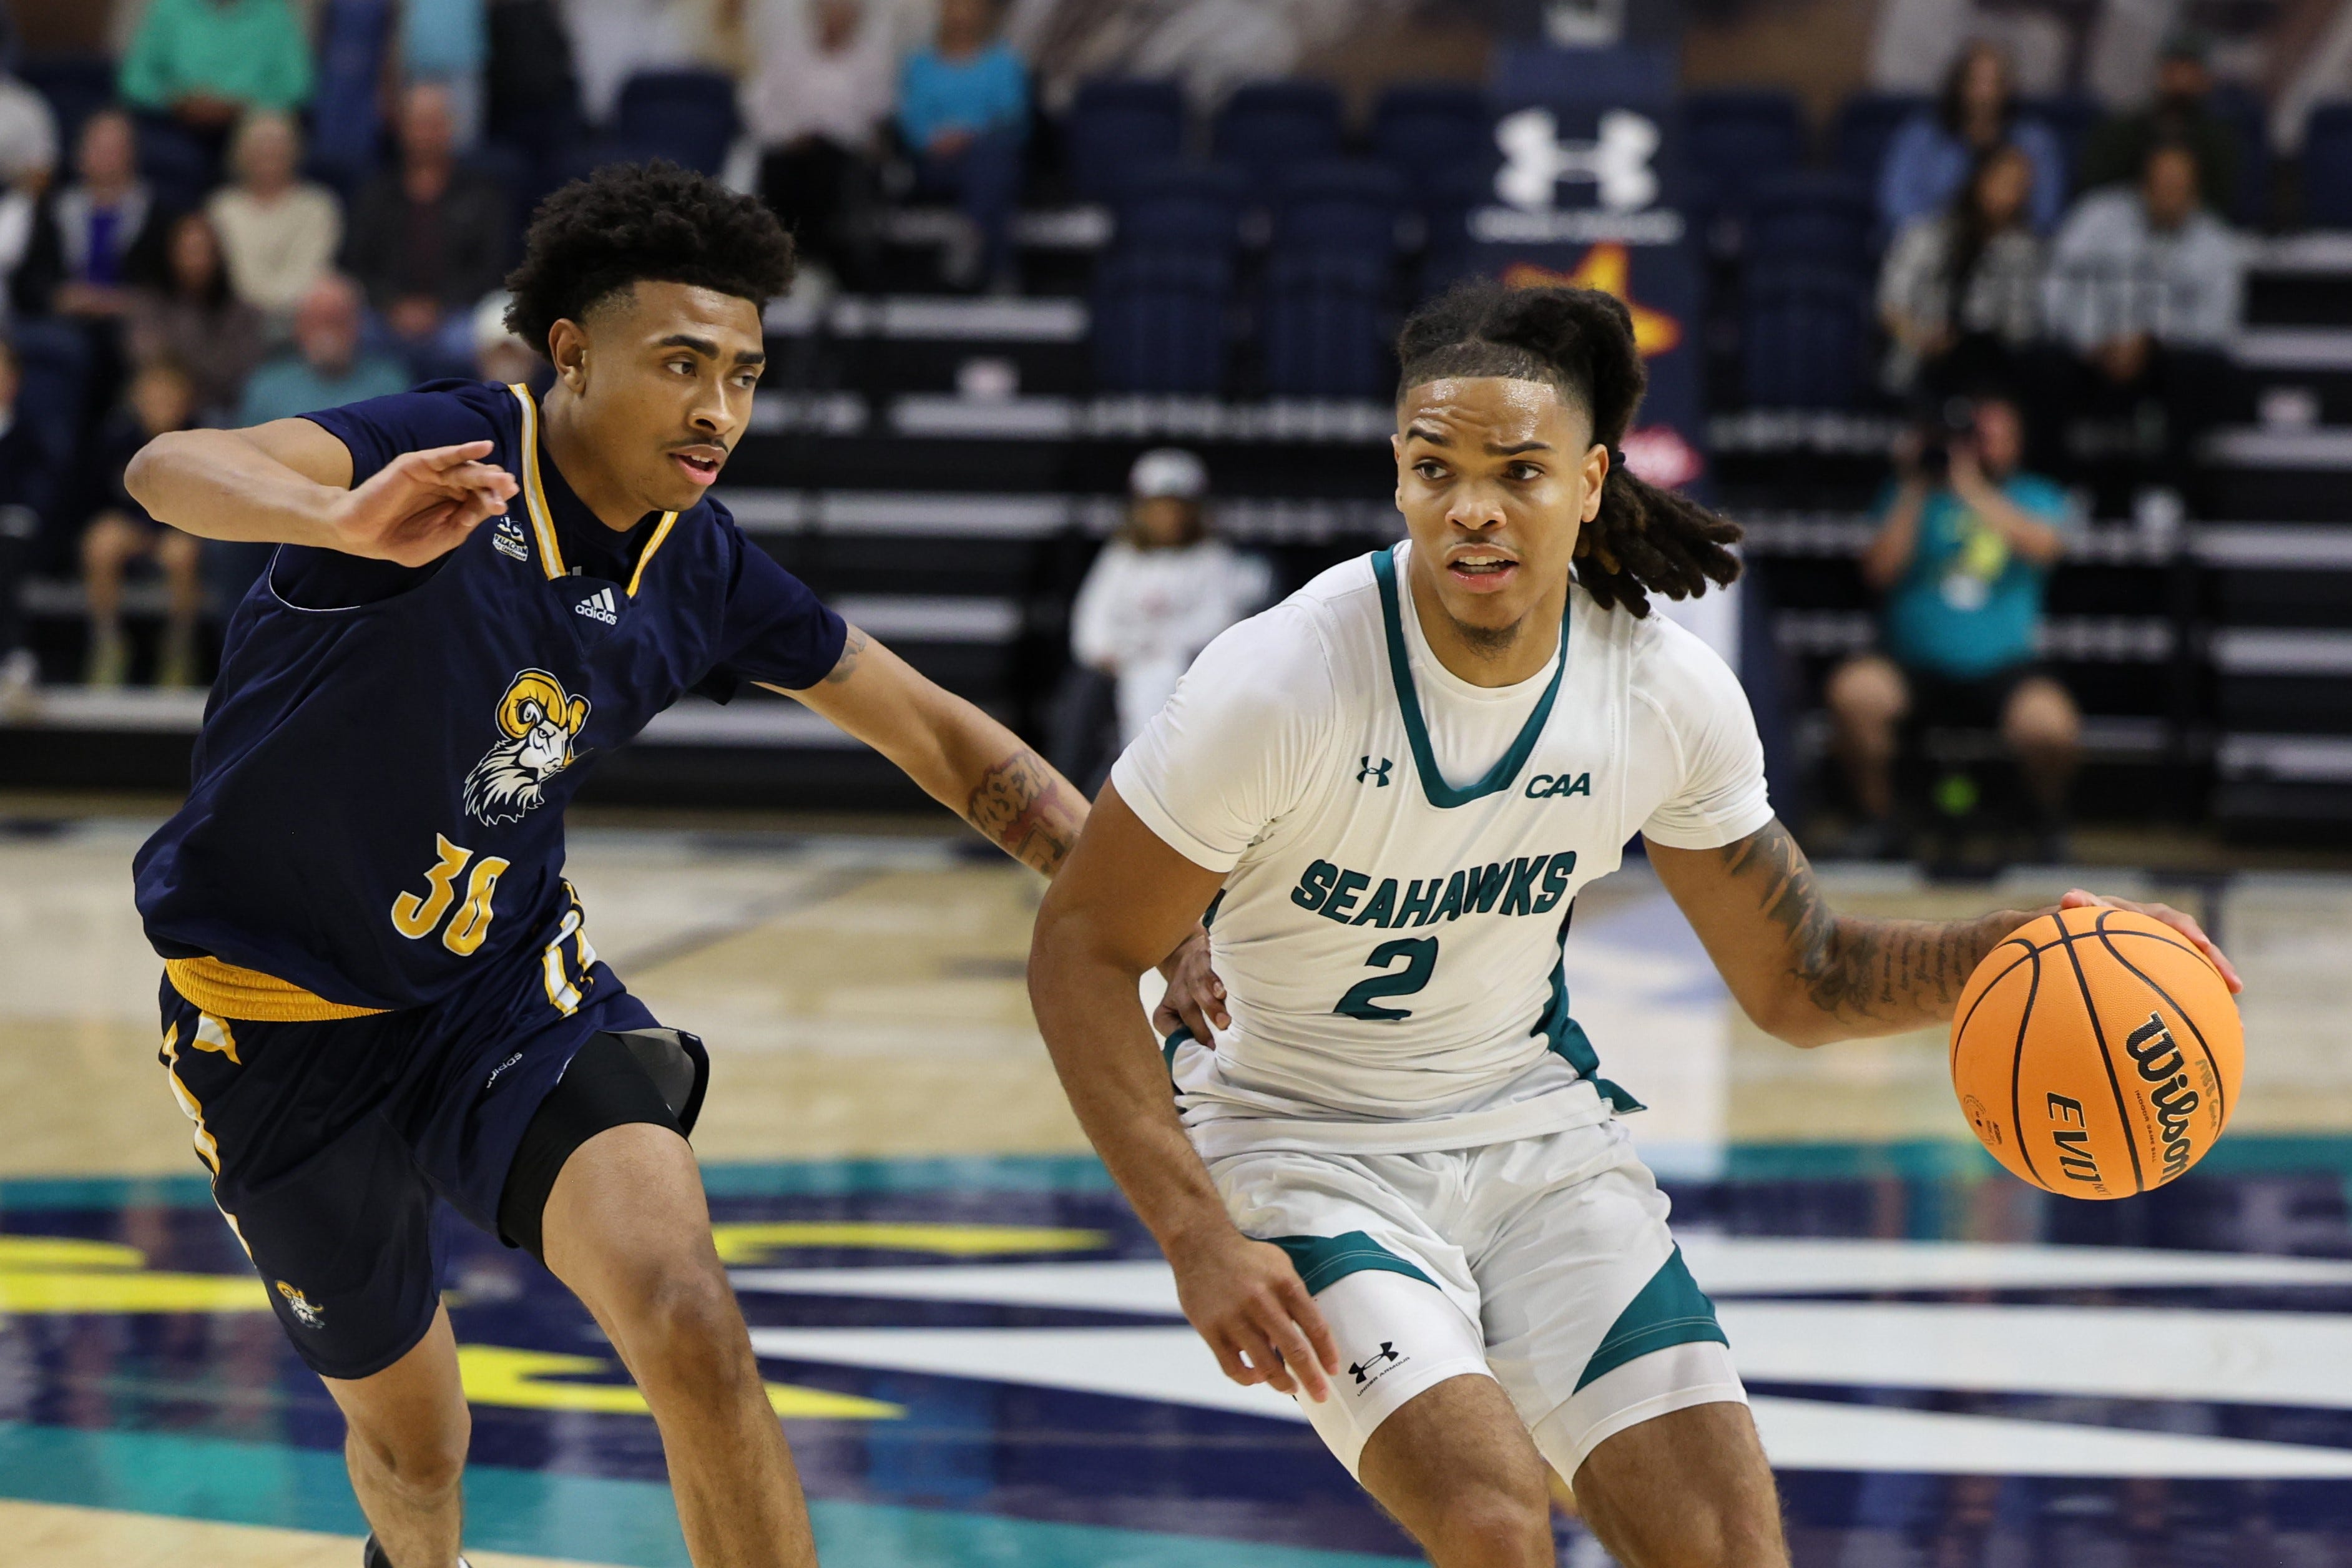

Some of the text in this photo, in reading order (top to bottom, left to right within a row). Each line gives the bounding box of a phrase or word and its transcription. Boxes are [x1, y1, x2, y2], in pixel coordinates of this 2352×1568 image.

[575, 604, 617, 625] adidas
[1525, 773, 1590, 798] CAA
[391, 832, 511, 957] 30
[1291, 851, 1577, 928] SEAHAWKS
[1333, 936, 1439, 1021] 2
[2126, 1011, 2199, 1184] Wilson
[2135, 1089, 2149, 1122] INDOOR
[2046, 1091, 2102, 1182] EVO
[1357, 1356, 1411, 1397] UNDER ARMOUR
